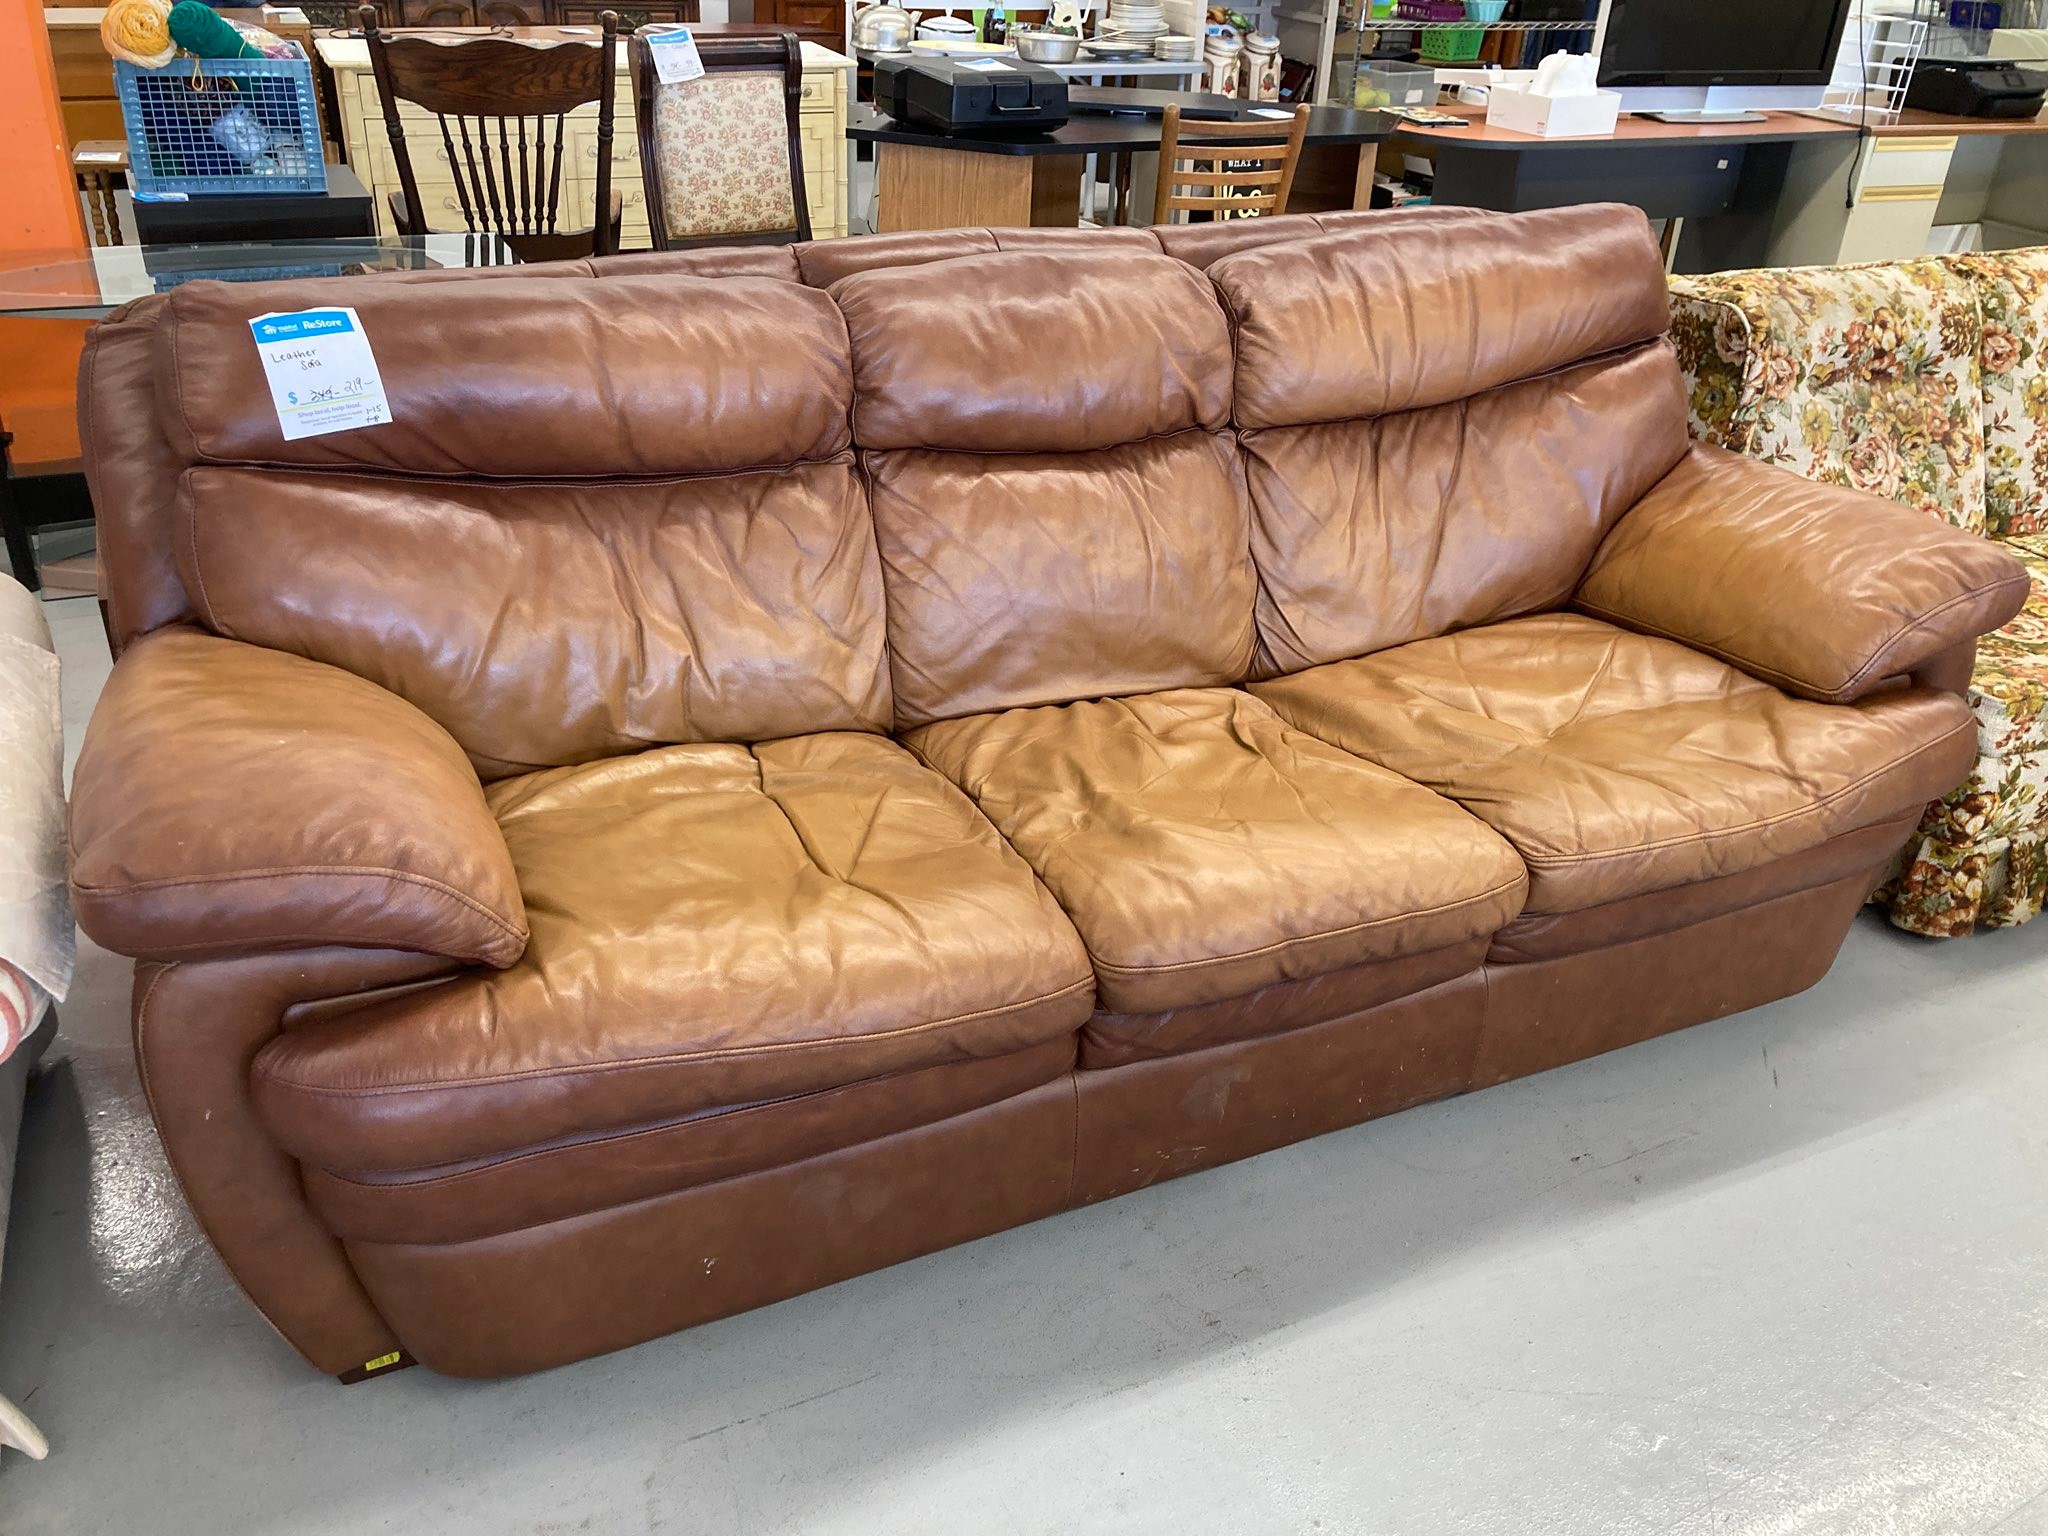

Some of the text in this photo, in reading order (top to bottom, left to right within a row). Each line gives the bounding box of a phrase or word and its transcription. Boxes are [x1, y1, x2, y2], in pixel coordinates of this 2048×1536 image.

[302, 319, 342, 330] ReStore
[271, 348, 317, 363] Leather
[300, 360, 322, 371] Sofa
